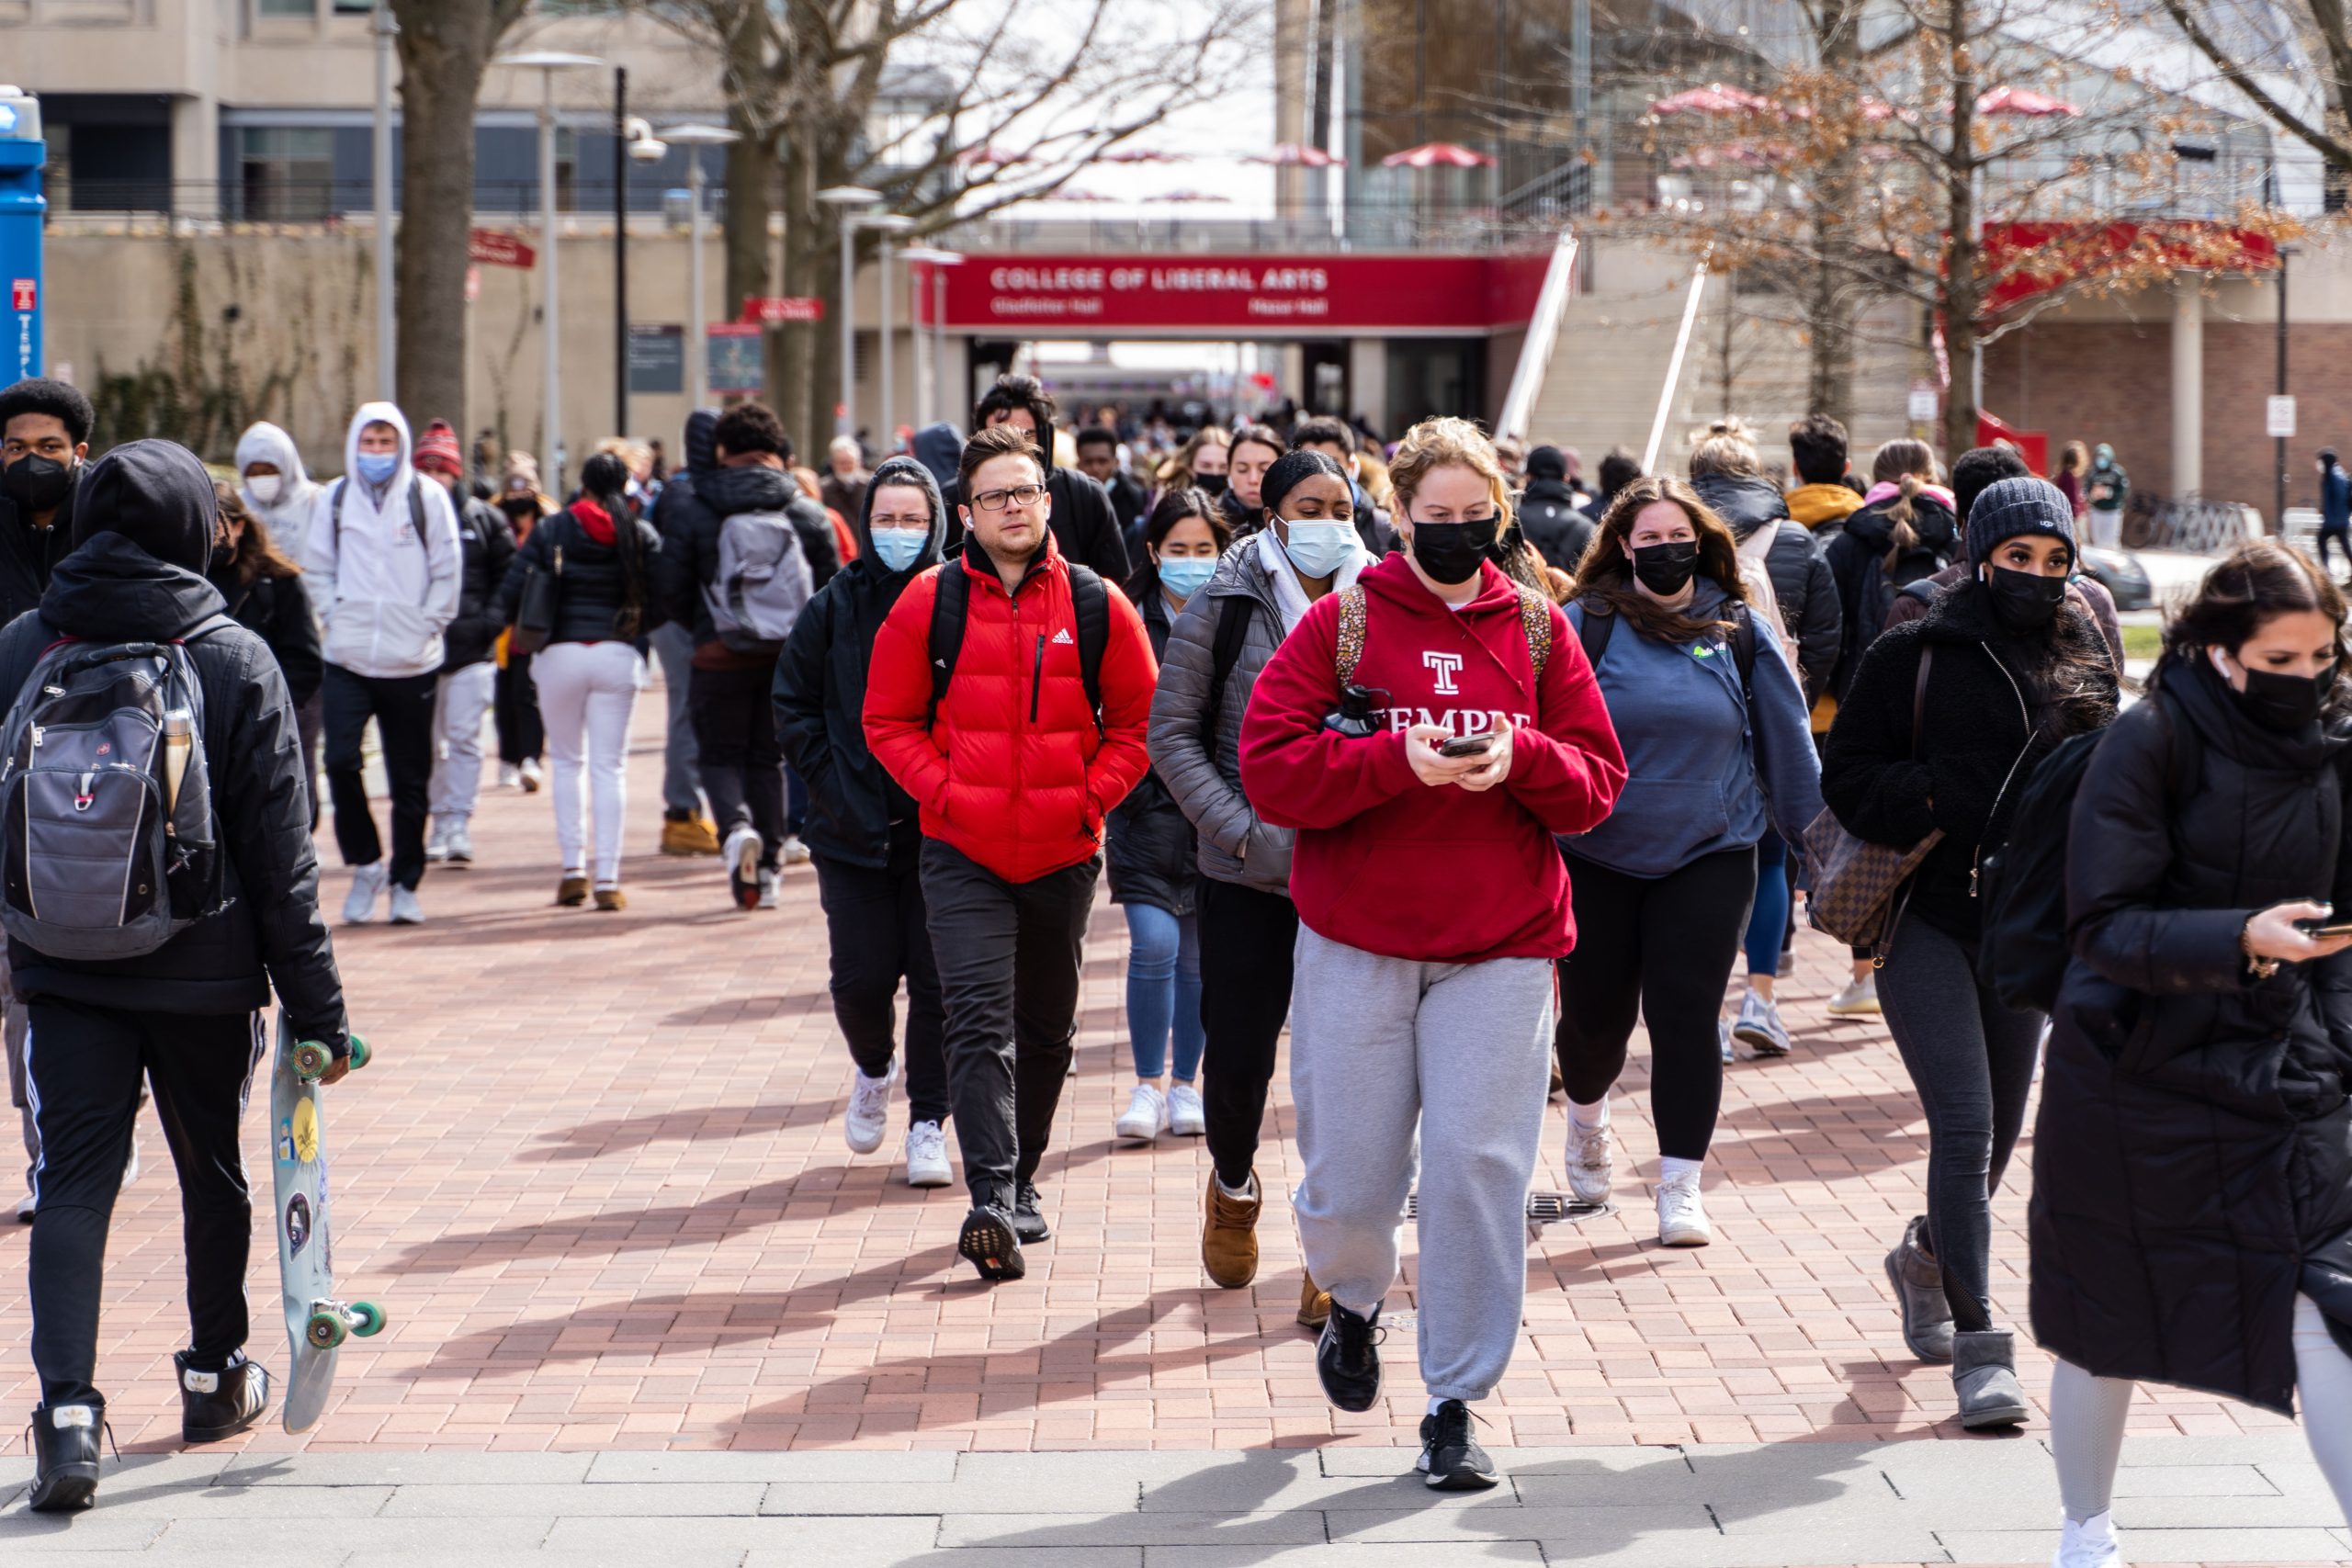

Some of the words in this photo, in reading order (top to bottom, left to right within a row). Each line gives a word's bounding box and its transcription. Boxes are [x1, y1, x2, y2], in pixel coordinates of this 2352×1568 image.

[990, 266, 1104, 290] COLLEGE
[1109, 267, 1147, 290] OF
[1150, 267, 1258, 290] LIBERAL
[1261, 267, 1329, 290] ARTS
[1422, 650, 1464, 695] T
[1367, 707, 1531, 741] EMPE
